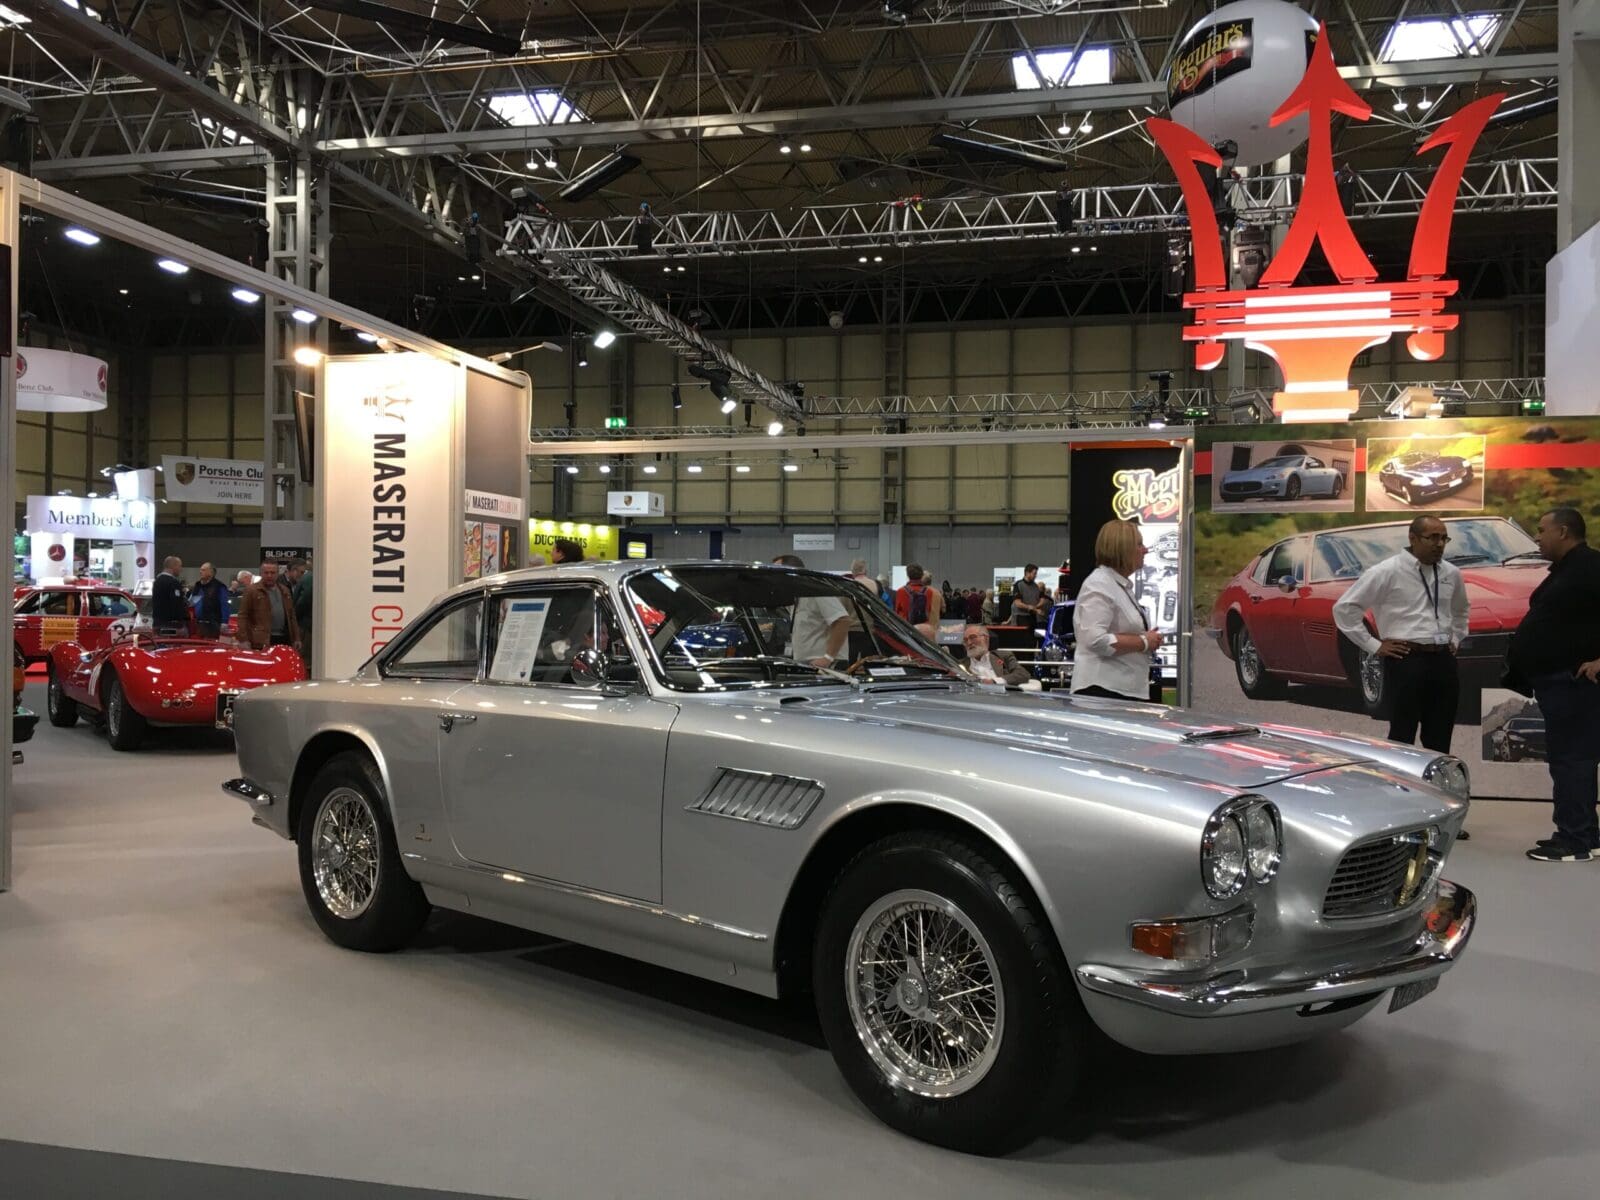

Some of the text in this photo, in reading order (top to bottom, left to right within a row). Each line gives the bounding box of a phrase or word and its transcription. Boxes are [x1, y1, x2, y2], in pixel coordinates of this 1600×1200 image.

[199, 465, 243, 477] Porsche
[472, 495, 499, 511] MASERATI
[48, 510, 126, 527] Members'
[373, 433, 406, 593] MASERATI
